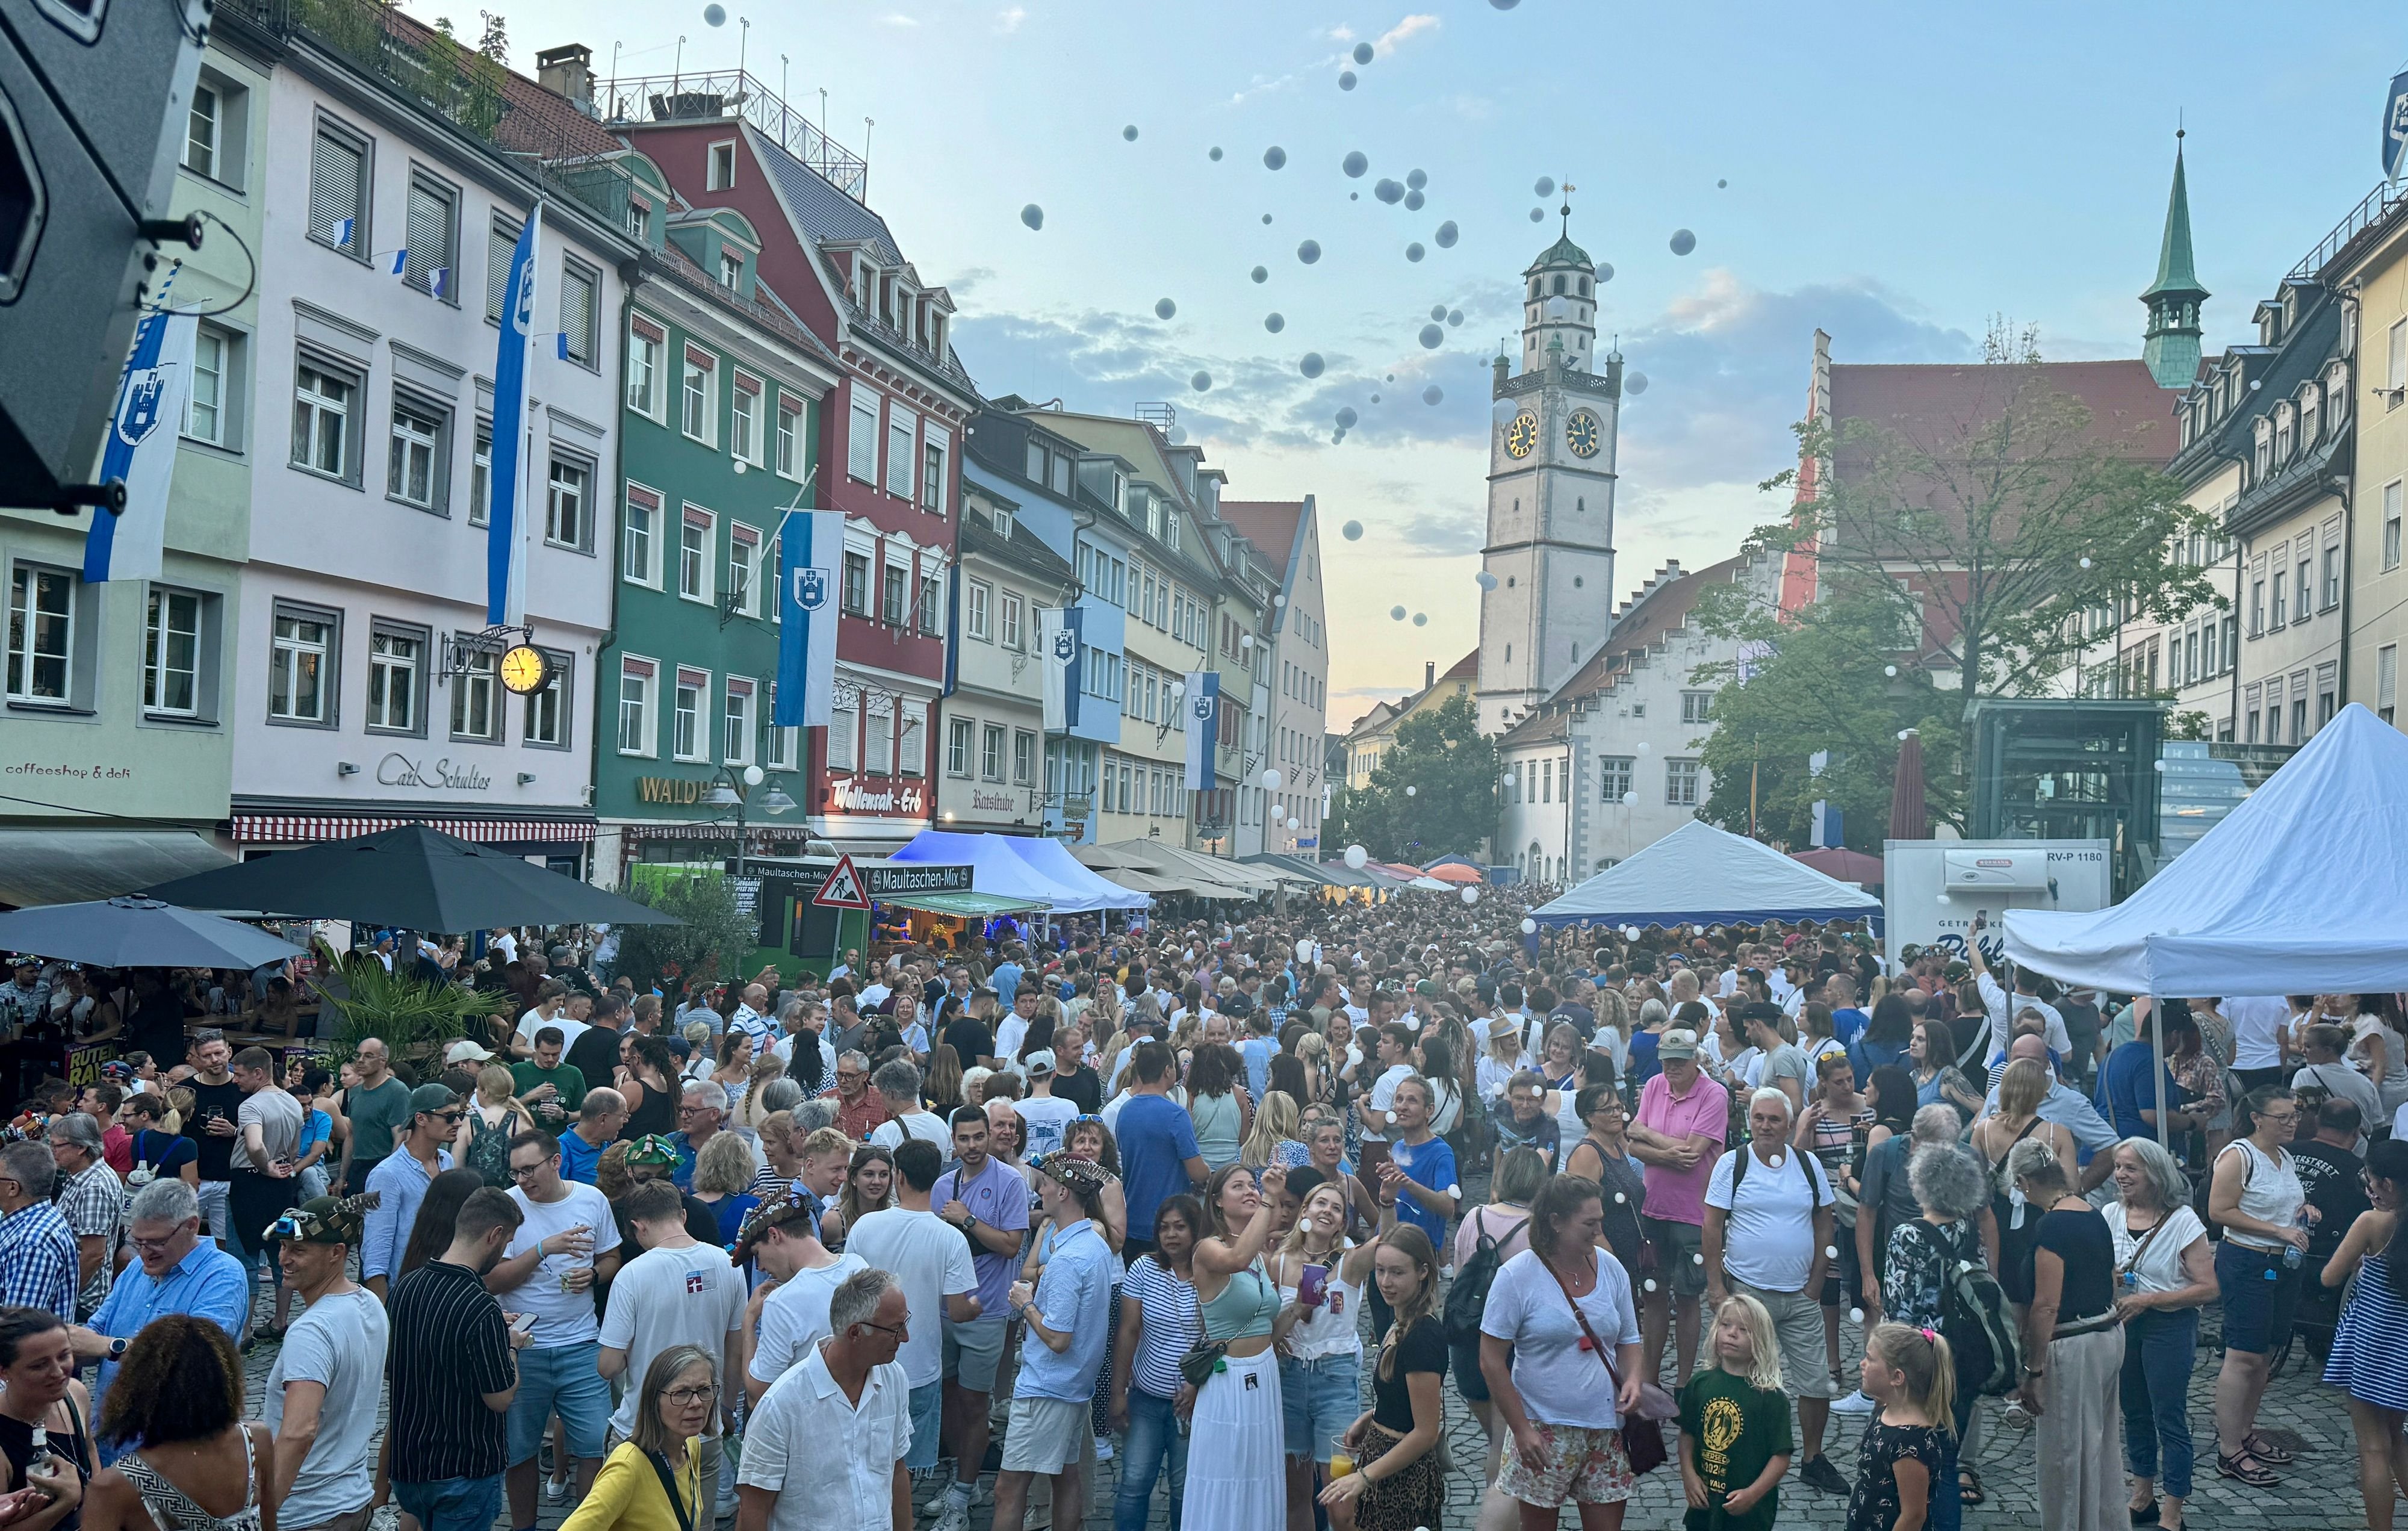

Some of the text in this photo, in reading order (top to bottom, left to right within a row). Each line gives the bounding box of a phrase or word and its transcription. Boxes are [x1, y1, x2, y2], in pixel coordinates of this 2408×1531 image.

[5, 763, 130, 779] coffeeshop & deli
[377, 752, 421, 786] Carl
[831, 778, 922, 813] Wollensak-Erb
[2047, 852, 2102, 862] RV-P 1180
[757, 866, 828, 881] Maultaschen-Mix
[883, 867, 958, 890] Maultaschen-Mix
[69, 1043, 116, 1069] RUTEN
[285, 1054, 334, 1071] REN
[2307, 1167, 2321, 1178] AIR
